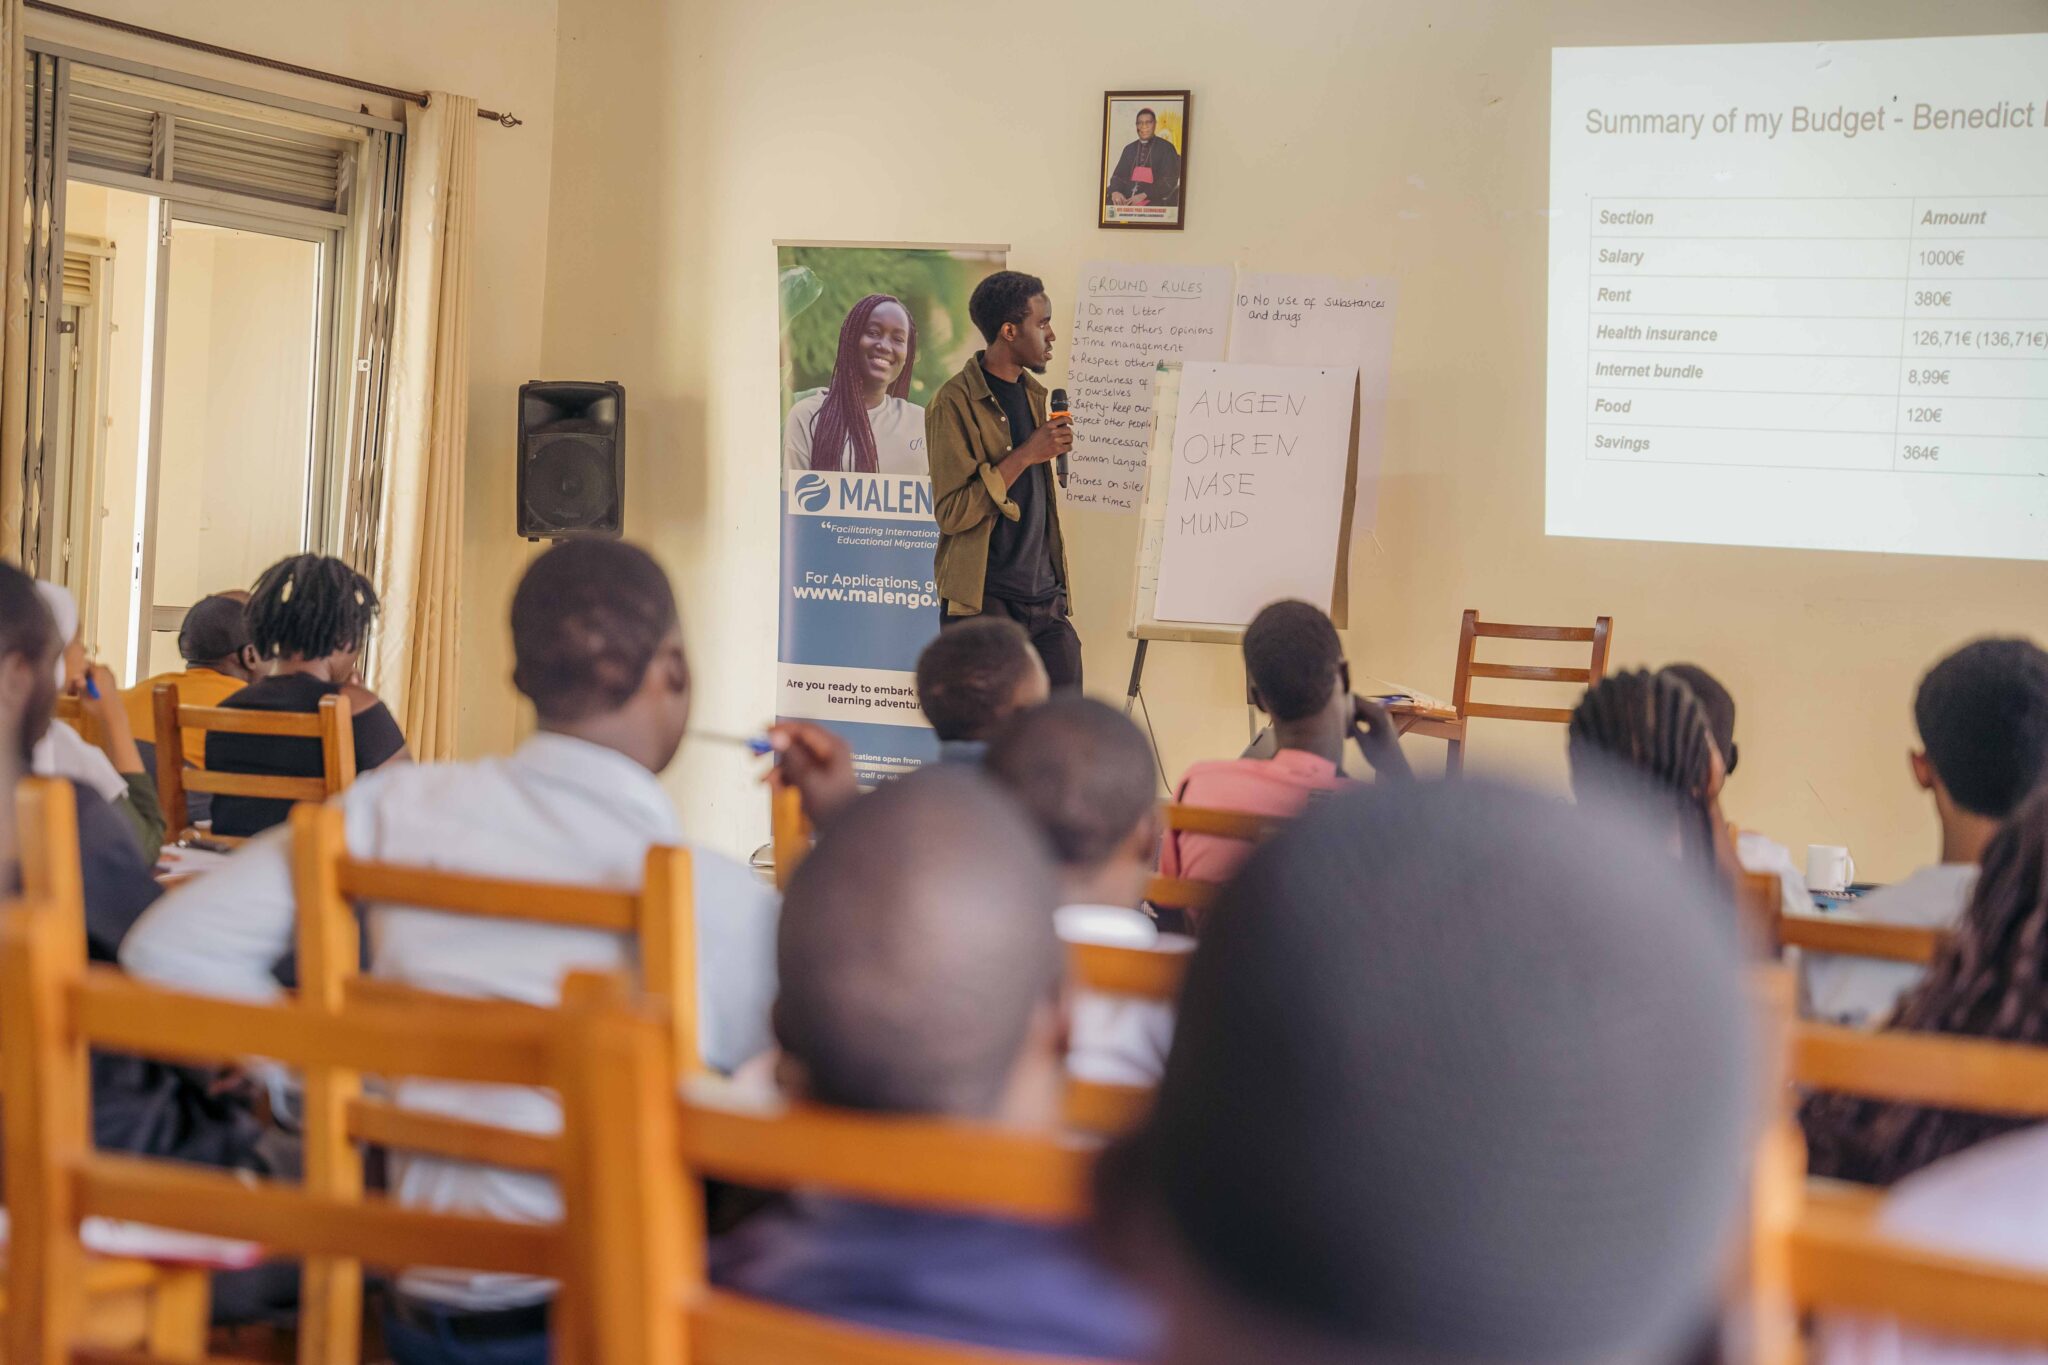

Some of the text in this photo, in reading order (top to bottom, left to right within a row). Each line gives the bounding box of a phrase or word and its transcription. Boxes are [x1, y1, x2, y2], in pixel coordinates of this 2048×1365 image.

[1586, 108, 1704, 140] Summary
[1712, 107, 1738, 133] of
[1744, 112, 1783, 140] my
[1792, 105, 1885, 138] Budget
[1912, 101, 2035, 130] Benedict
[1600, 209, 1654, 225] Section
[1920, 209, 1987, 225] Amount
[1598, 248, 1645, 266] Salary
[1919, 249, 1966, 266] 1000€
[1088, 275, 1203, 294] GROUND RULES
[1253, 293, 1270, 306] No
[1277, 296, 1299, 306] use
[1303, 297, 1316, 310] of
[1597, 287, 1632, 302] Rent
[1914, 291, 1952, 306] 380€
[1088, 303, 1103, 316] Do
[1107, 305, 1124, 316] not
[1087, 320, 1124, 335] Respect
[1248, 310, 1302, 328] and drugs
[1596, 325, 1719, 341] Health insurance
[1912, 330, 1972, 348] 126,71€
[1082, 336, 1105, 347] Time
[1111, 339, 1184, 355] management
[1080, 354, 1120, 367] Respect
[1595, 361, 1704, 379] Internet bundle
[1907, 369, 1950, 386] 8,99€
[1076, 372, 1133, 385] Cleanliness
[1139, 378, 1148, 390] of
[1190, 388, 1306, 418] AUGEN
[1594, 398, 1632, 413] Food
[1906, 407, 1943, 423] 120€
[1183, 433, 1298, 464] OHREN
[1594, 434, 1651, 453] Savings
[1902, 445, 1940, 460] 364€
[1069, 472, 1102, 486] Phones
[1107, 480, 1119, 489] on
[1184, 472, 1256, 501] NASE
[1066, 489, 1132, 508] break times
[1180, 511, 1249, 535] MUND
[837, 536, 892, 547] Educational
[805, 571, 829, 584] For
[832, 573, 922, 592] Applications,
[793, 585, 941, 609] www.malengo.
[786, 678, 804, 689] Are
[805, 681, 825, 691] you
[828, 682, 858, 694] ready
[861, 684, 871, 693] to
[874, 686, 914, 697] embark
[828, 694, 872, 707] learning
